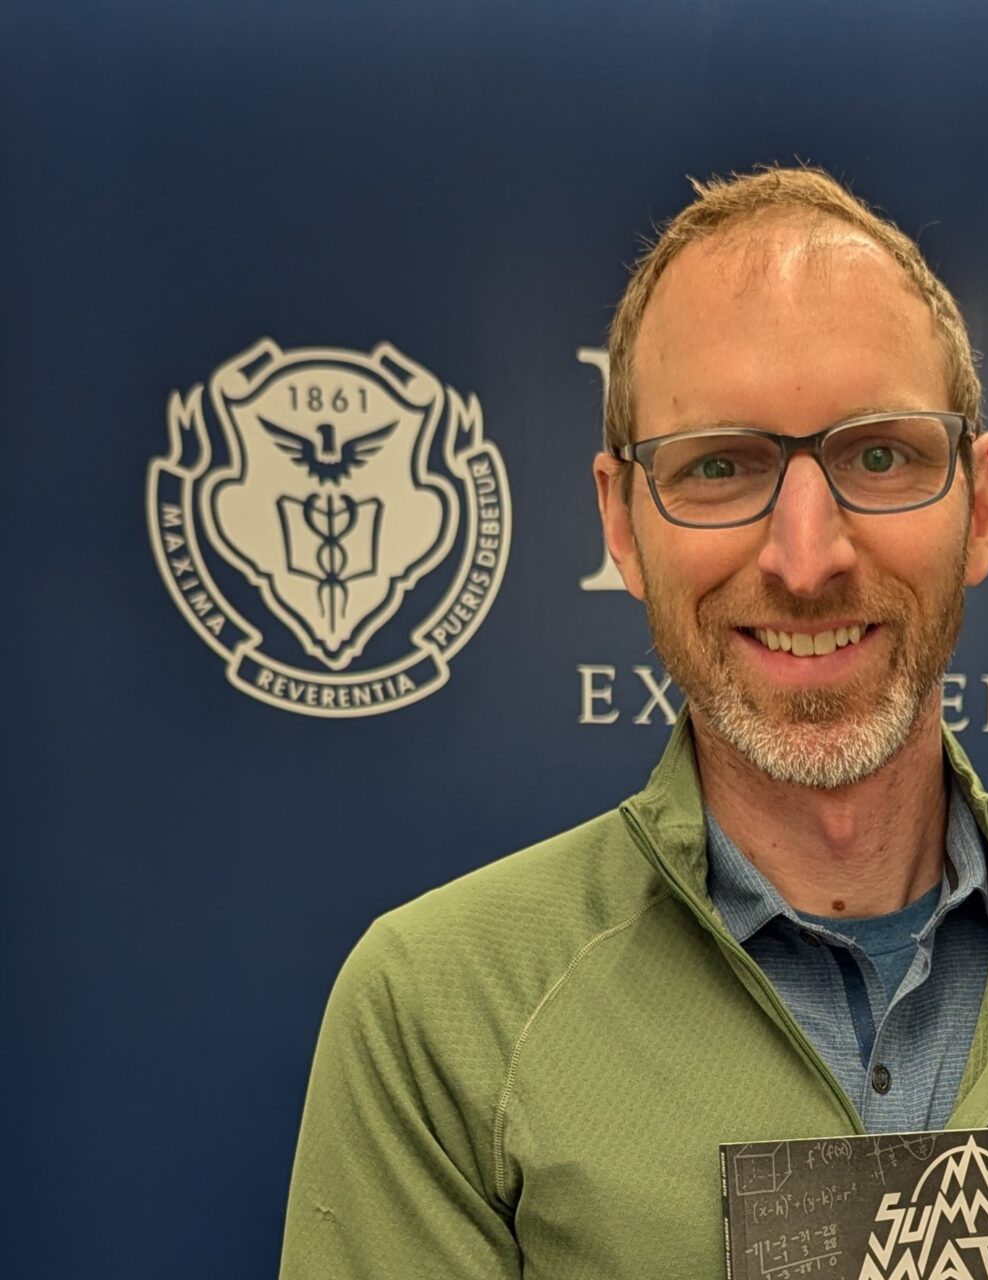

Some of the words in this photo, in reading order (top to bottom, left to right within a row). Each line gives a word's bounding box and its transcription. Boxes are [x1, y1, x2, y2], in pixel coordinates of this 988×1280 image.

[287, 385, 370, 414] 1861
[161, 503, 226, 636] MAXIMA
[431, 570, 491, 646] PUERIS
[472, 457, 500, 569] DEBETUR
[256, 668, 418, 709] REVERENTIA
